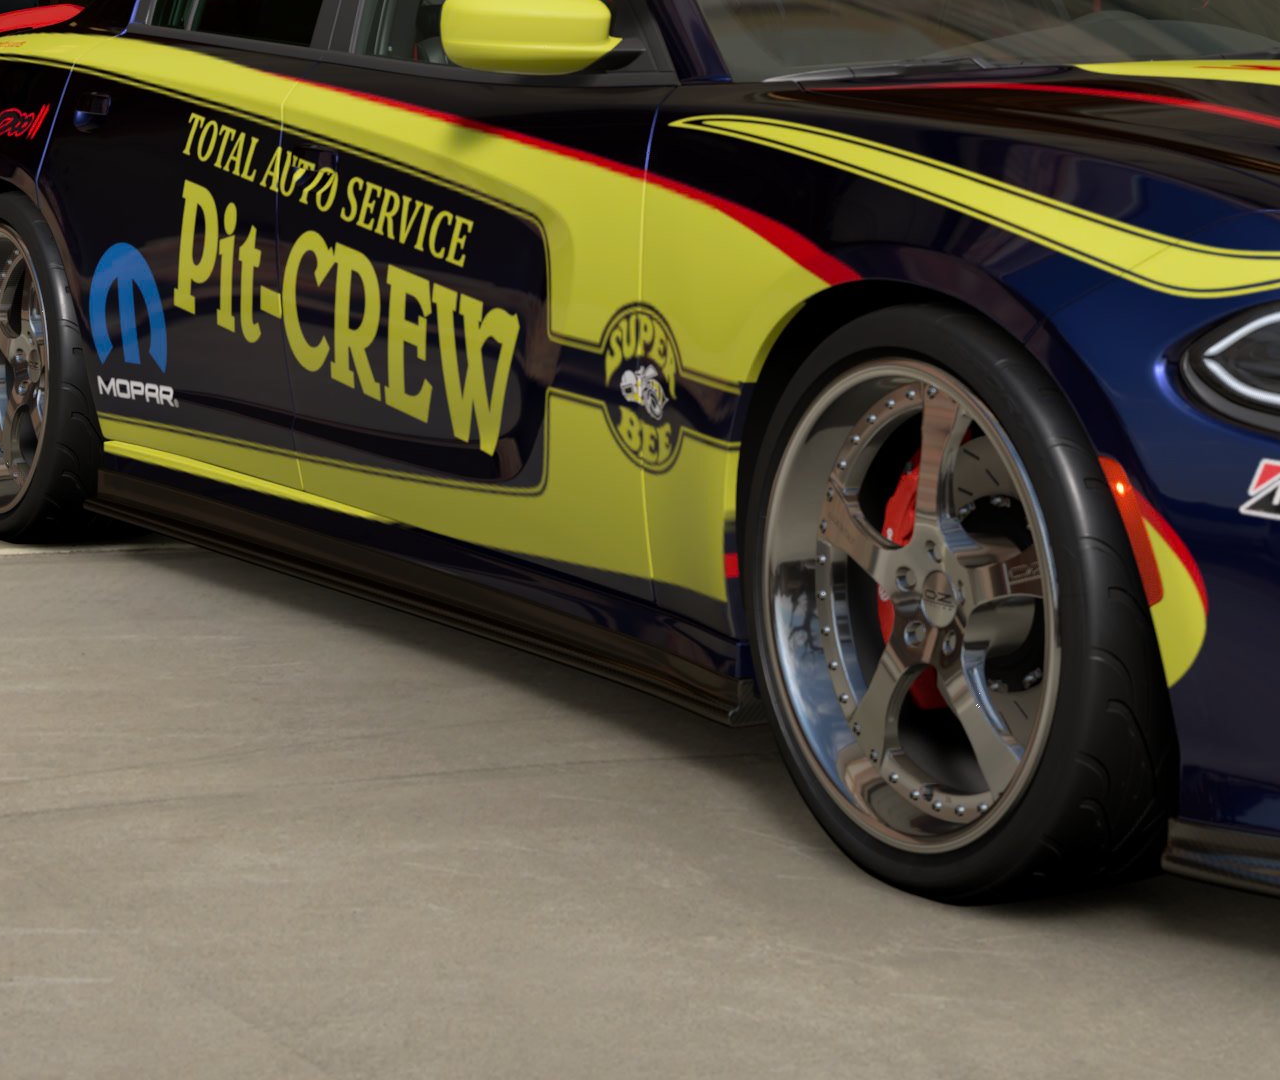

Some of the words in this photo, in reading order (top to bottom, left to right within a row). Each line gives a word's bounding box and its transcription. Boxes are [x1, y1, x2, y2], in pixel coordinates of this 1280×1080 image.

[182, 112, 259, 182] TOTAL
[260, 146, 339, 212] AUTO
[340, 176, 474, 267] SERVICE
[173, 179, 520, 457] Pit-CREW
[605, 312, 677, 400] SUPER
[97, 375, 175, 407] MOPAR
[618, 405, 672, 464] BEE
